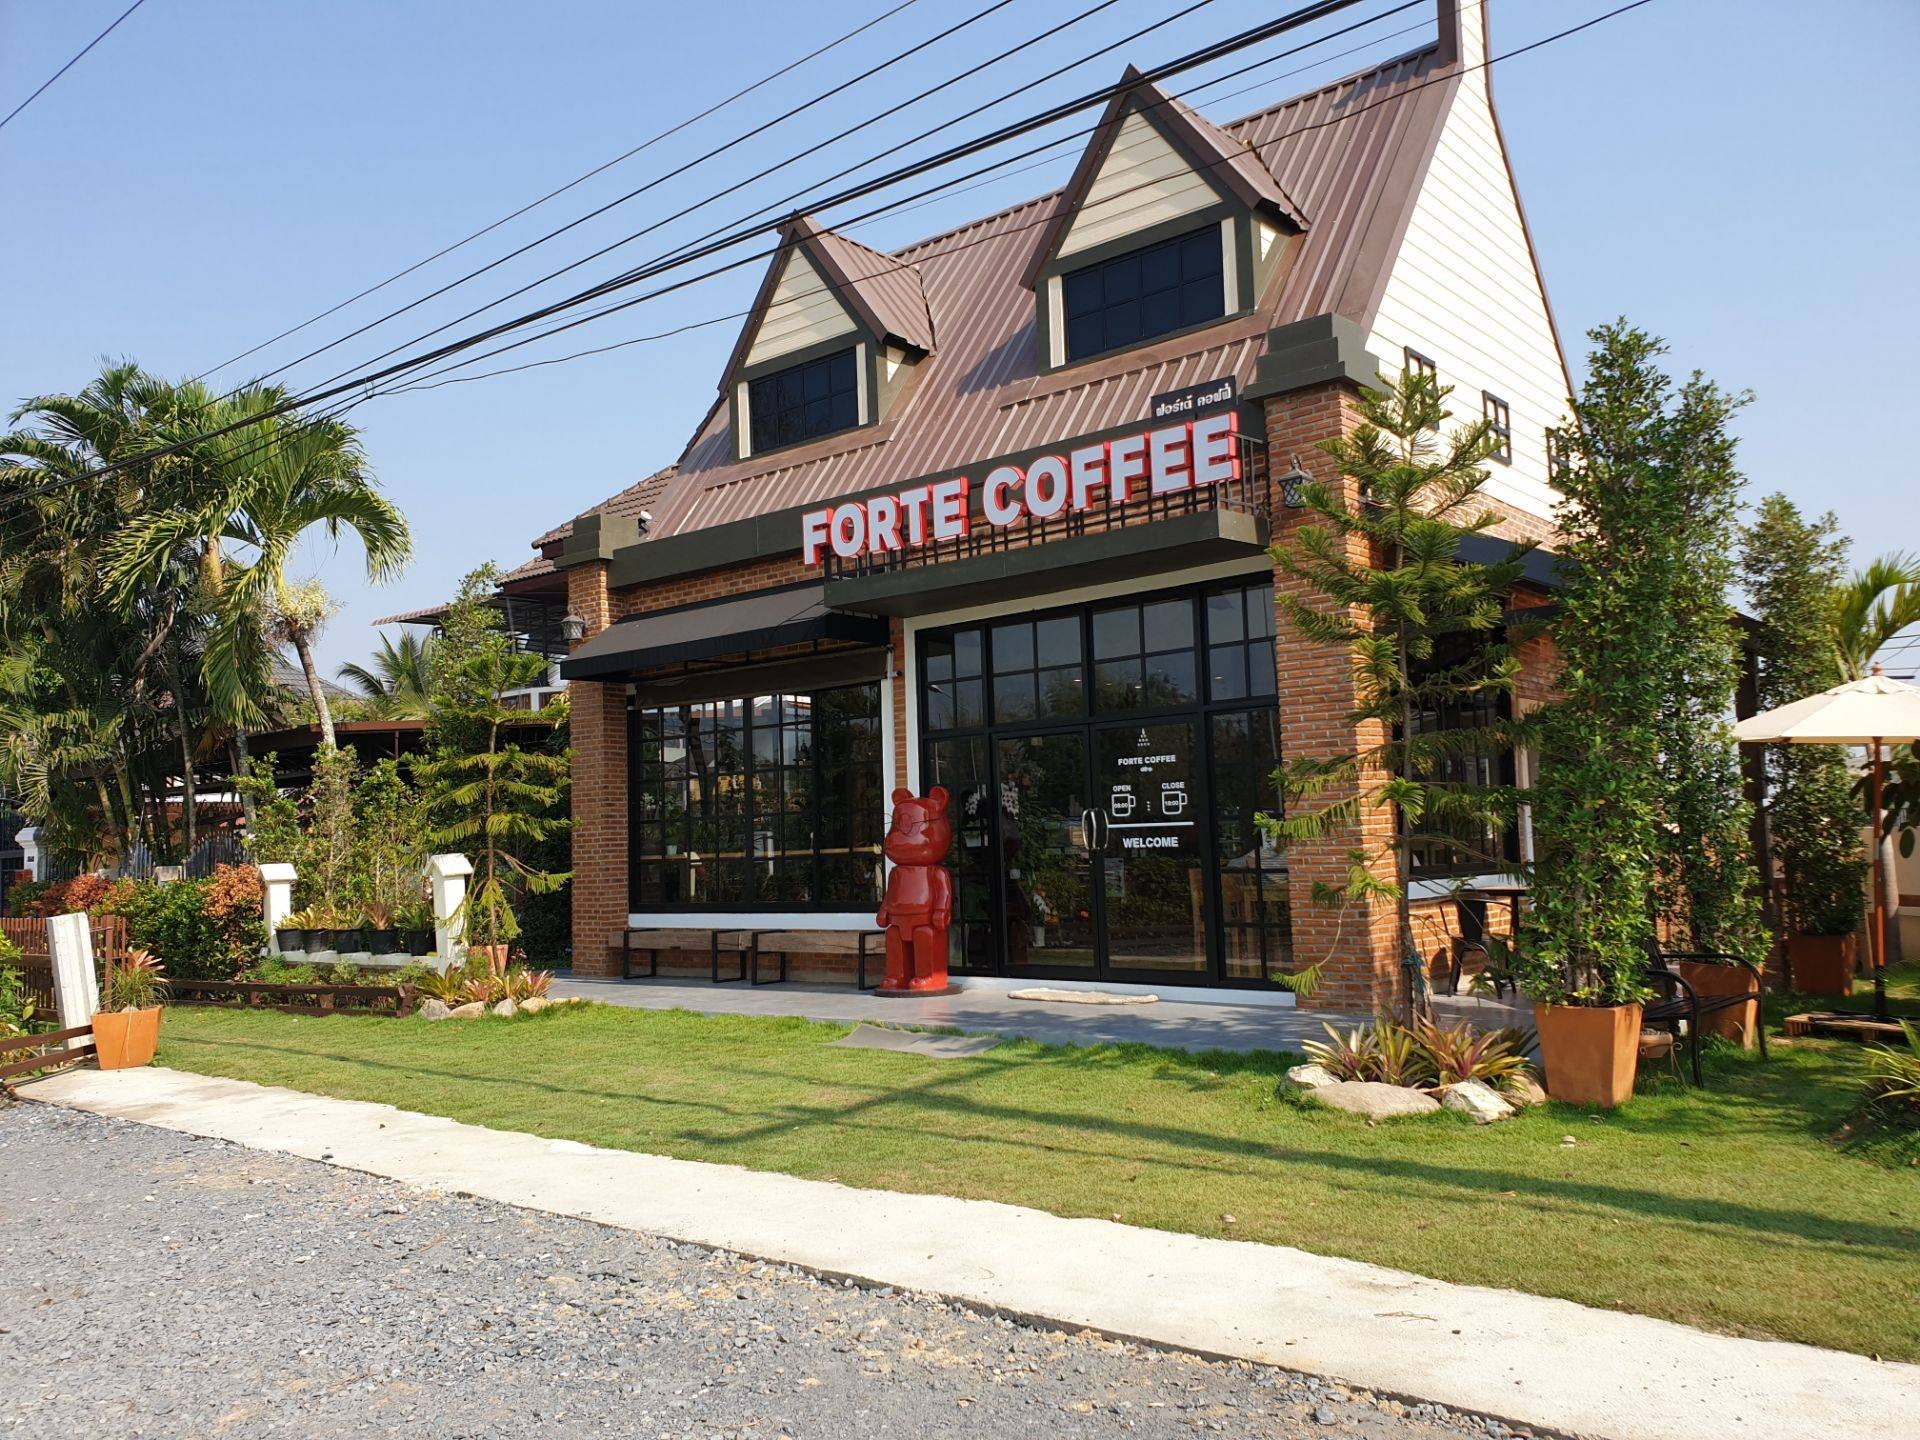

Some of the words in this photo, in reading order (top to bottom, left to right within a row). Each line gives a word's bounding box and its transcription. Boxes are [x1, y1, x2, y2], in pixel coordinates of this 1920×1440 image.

[802, 476, 969, 566] FORTE
[982, 411, 1240, 527] COFFEE
[1118, 757, 1143, 765] FORTE
[1144, 755, 1176, 763] COFFEE
[1122, 837, 1178, 848] WELCOME
